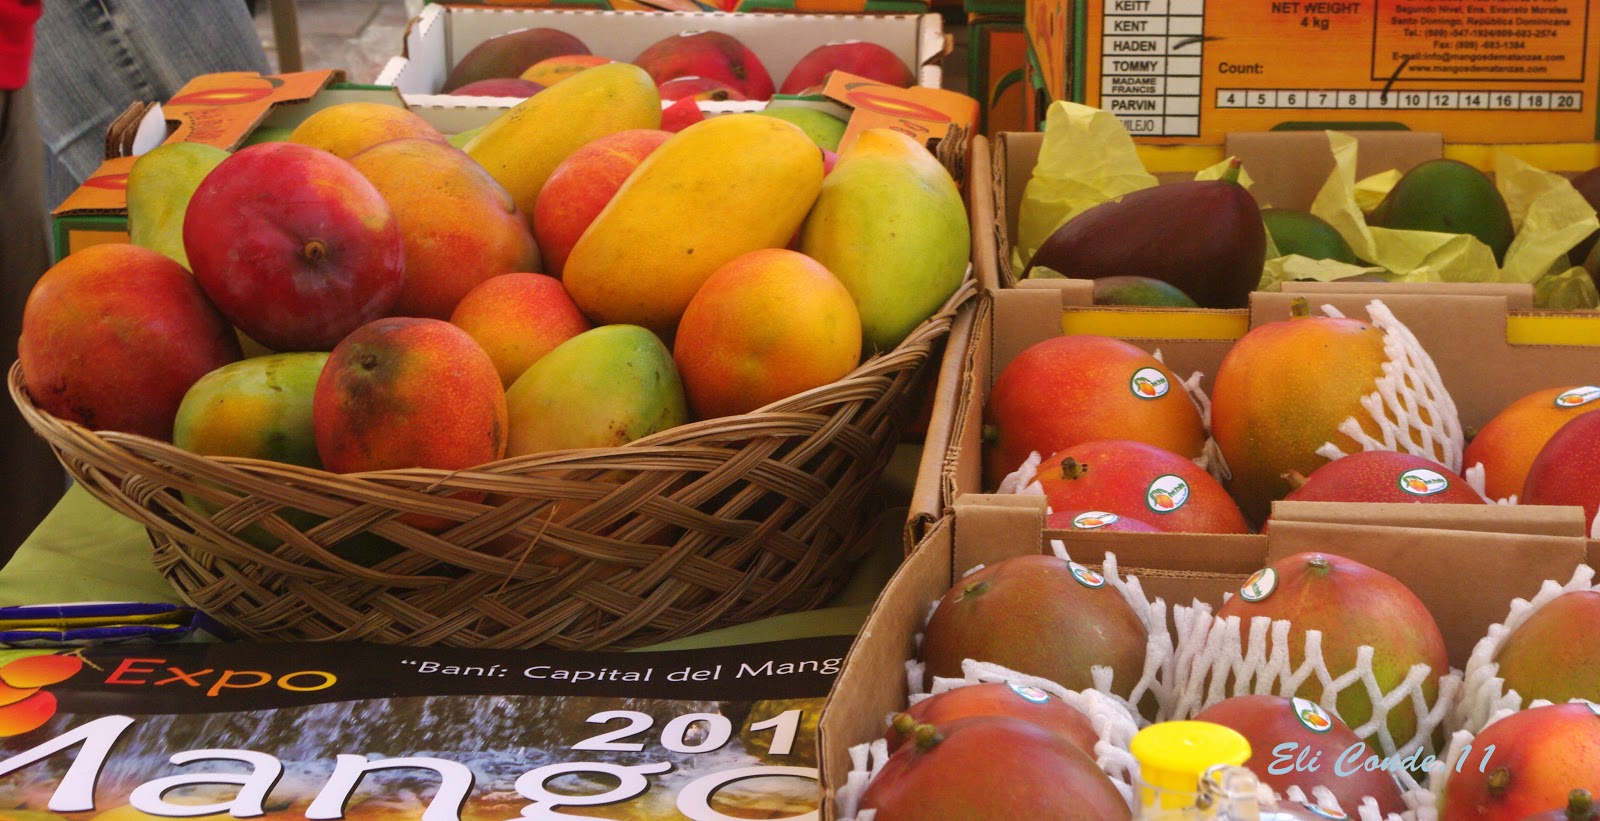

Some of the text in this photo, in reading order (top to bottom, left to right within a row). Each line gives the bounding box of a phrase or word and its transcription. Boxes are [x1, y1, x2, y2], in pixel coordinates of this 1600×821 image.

[1115, 1, 1151, 11] KEITT
[1271, 3, 1361, 14] NET WEIGHT
[1300, 17, 1330, 30] 4 kg
[1391, 16, 1418, 25] Santo
[1114, 21, 1149, 32] KENT
[1113, 41, 1157, 51] HADEN
[1113, 61, 1158, 72] TOMMY
[1218, 62, 1264, 74] Count:
[1111, 100, 1156, 111] PARVIN
[1226, 93, 1236, 104] 4
[1257, 94, 1266, 105] 5
[1287, 94, 1296, 105] 6
[1319, 94, 1328, 105] 7
[1348, 94, 1357, 105] 8
[1405, 94, 1420, 106] 10
[1434, 95, 1450, 106] 12
[1465, 95, 1481, 106] 14
[1497, 95, 1512, 107] 16
[1528, 95, 1543, 107] 18
[1557, 95, 1574, 107] 20
[104, 657, 338, 697] Expo
[523, 665, 654, 683] Capital
[666, 664, 722, 683] del
